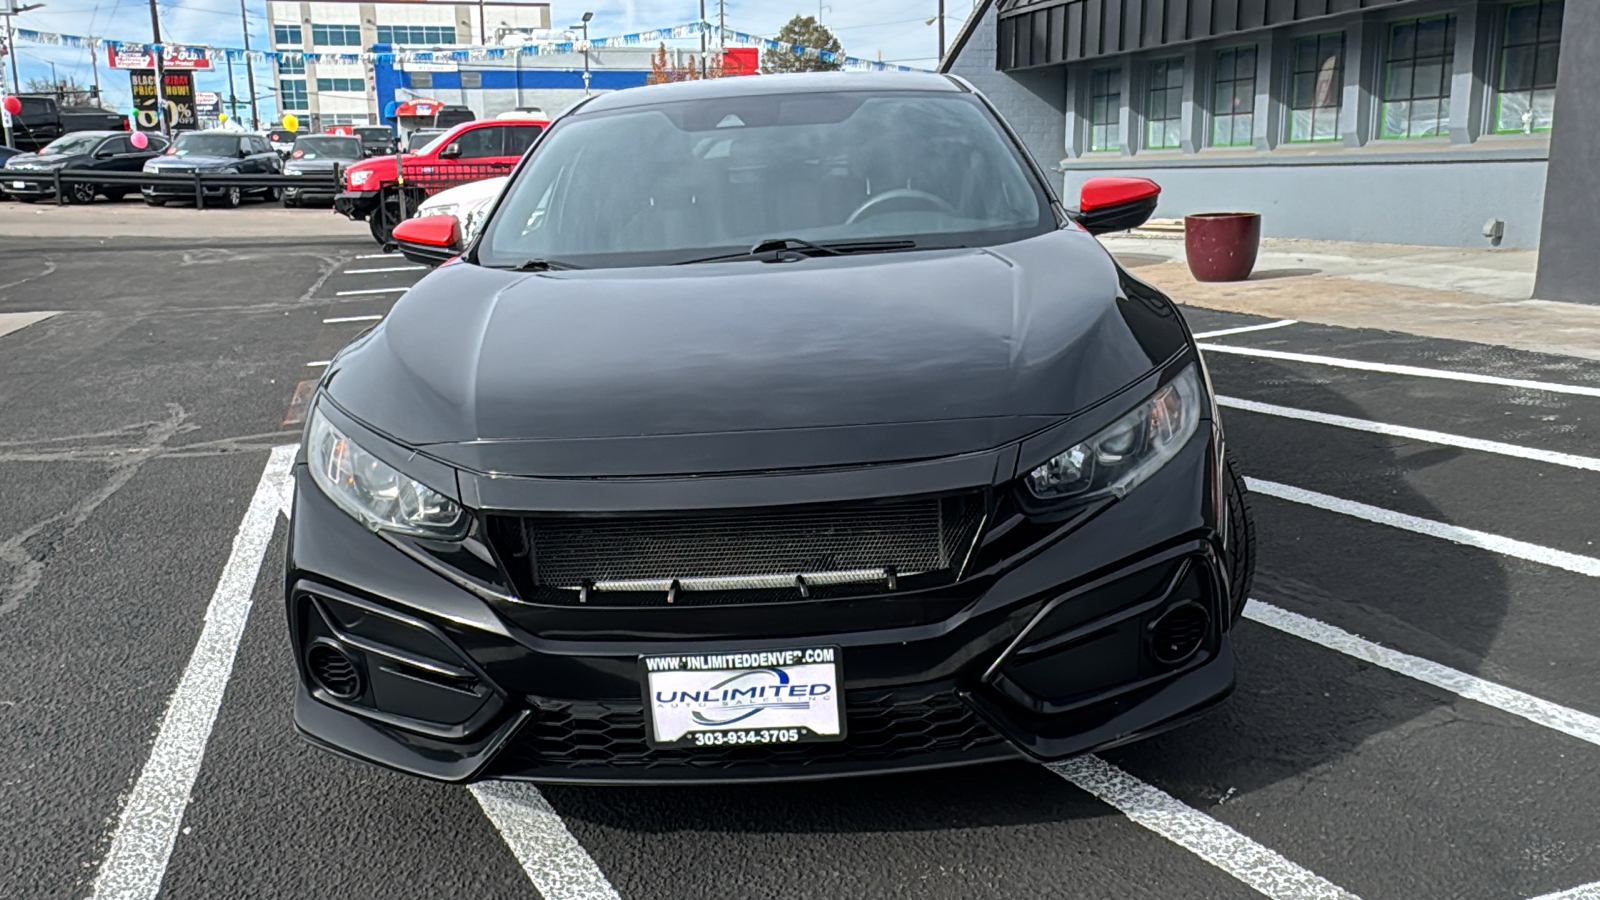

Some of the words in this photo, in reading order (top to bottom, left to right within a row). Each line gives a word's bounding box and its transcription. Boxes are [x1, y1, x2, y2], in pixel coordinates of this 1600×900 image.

[164, 75, 188, 85] RIDAY
[656, 683, 832, 703] UNLIMITED
[722, 697, 783, 707] SALES
[694, 729, 799, 746] 303-934-3705
